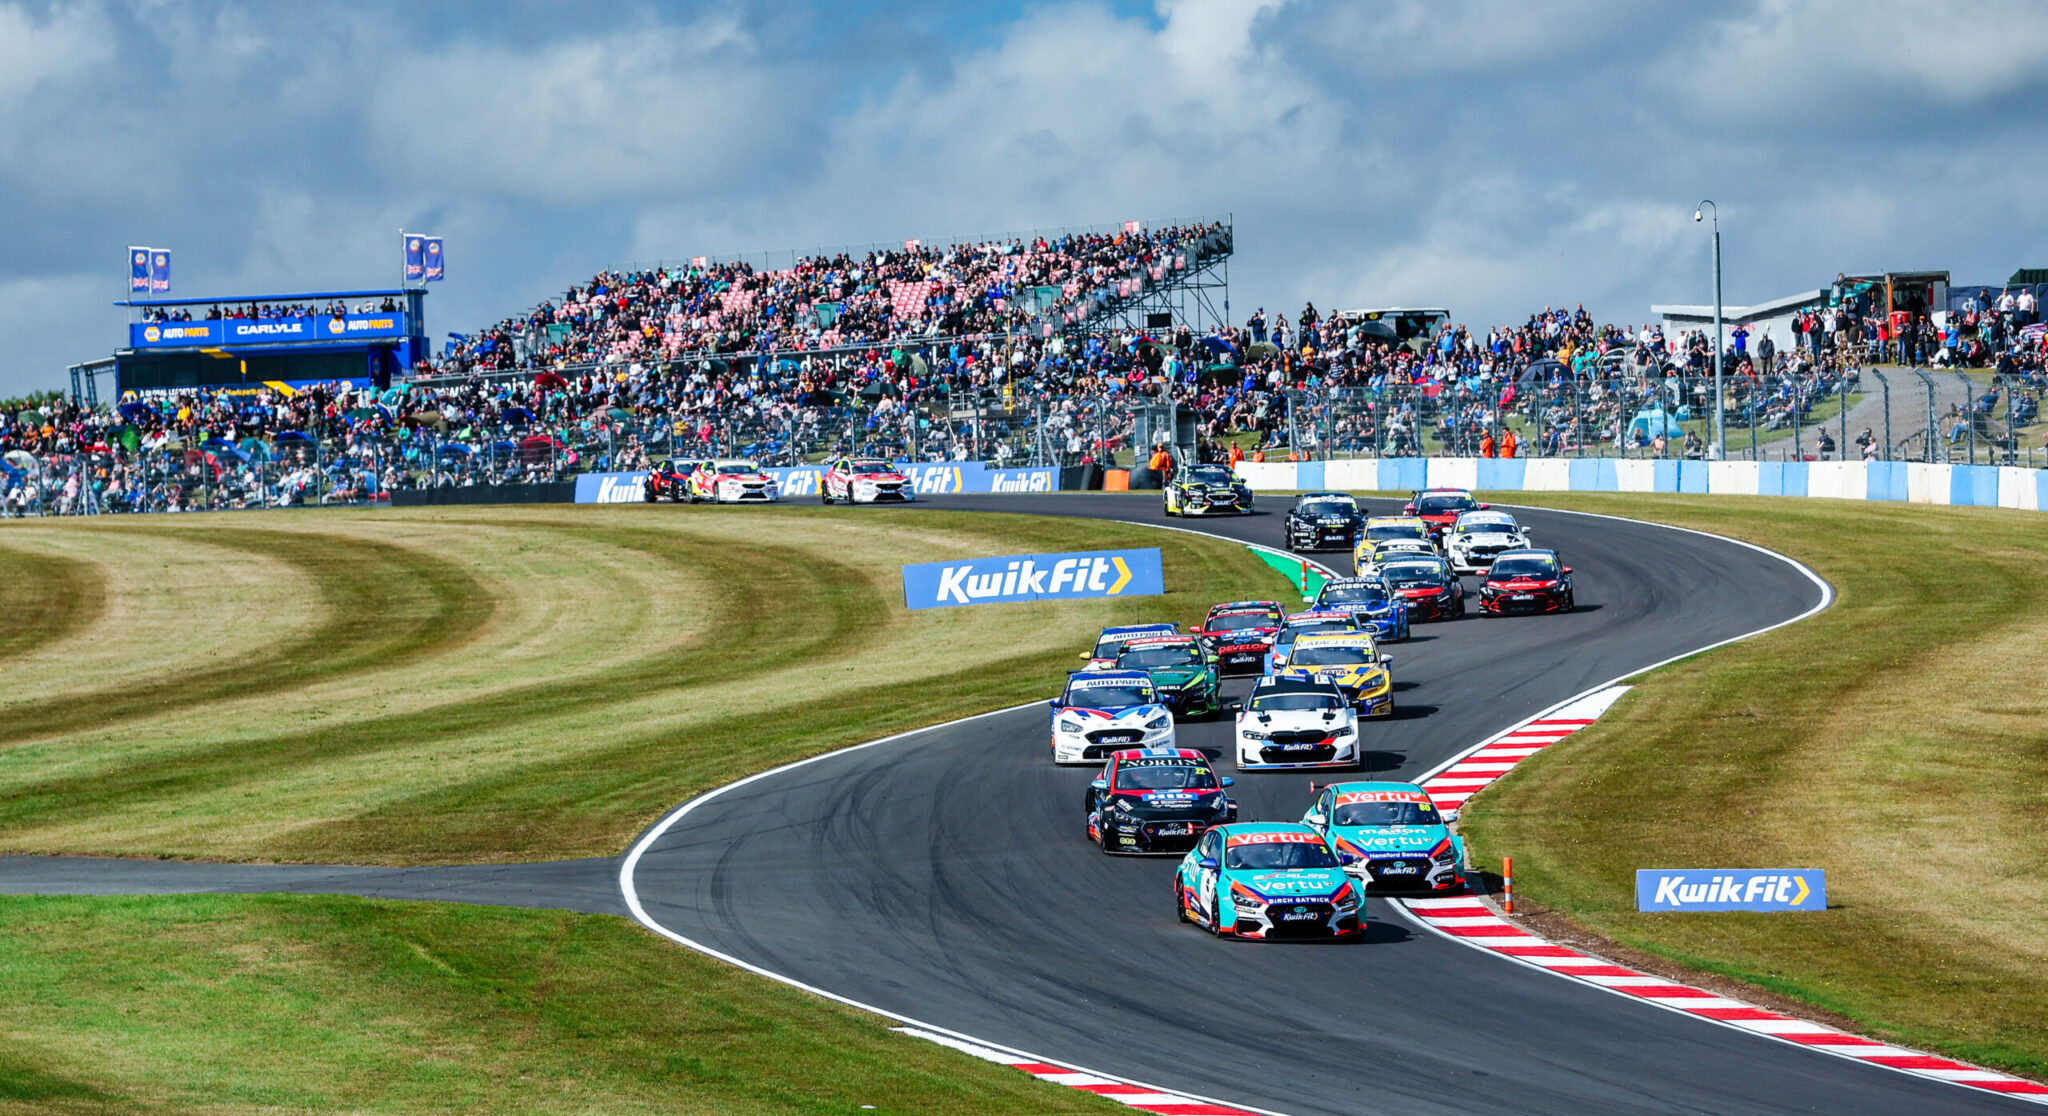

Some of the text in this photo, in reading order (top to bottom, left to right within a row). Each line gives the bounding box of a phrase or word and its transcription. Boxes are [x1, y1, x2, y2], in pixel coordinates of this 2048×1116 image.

[236, 323, 303, 335] CARLYLE
[348, 319, 394, 330] AUTO PARTS
[163, 327, 209, 338] AUTO PARTS
[1086, 678, 1149, 687] AUTO PARTS
[1125, 759, 1198, 767] NORLIN
[1195, 767, 1206, 775] 22
[1295, 896, 1330, 904] GATWICK
